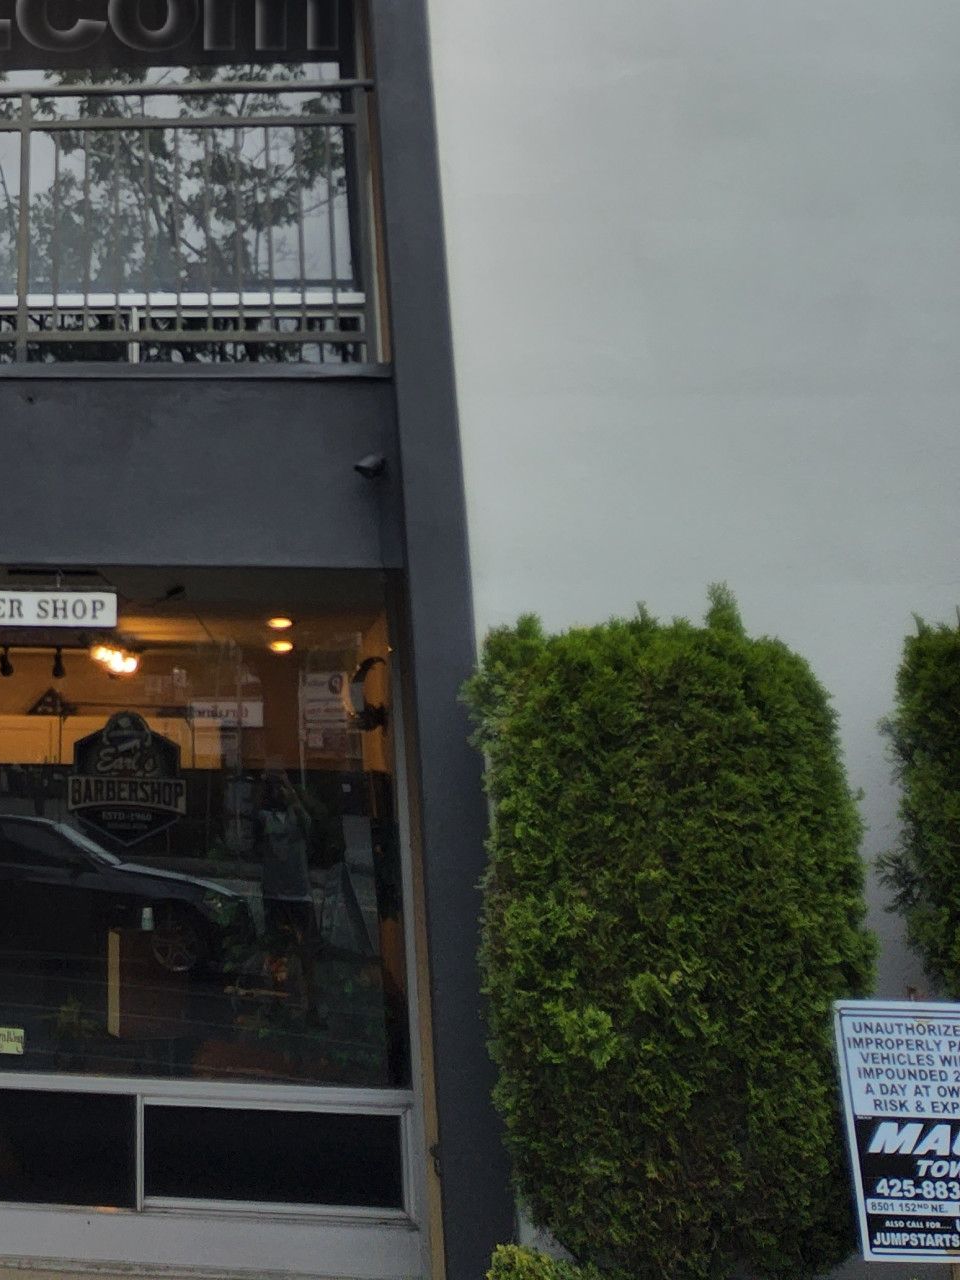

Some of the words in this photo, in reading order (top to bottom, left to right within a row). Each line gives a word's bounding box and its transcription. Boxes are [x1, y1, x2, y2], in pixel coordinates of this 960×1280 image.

[36, 598, 106, 621] SHOP
[71, 778, 183, 809] BARBERSHOP
[847, 1037, 942, 1051] IMPROPERLY
[860, 1052, 935, 1066] VEHICLES
[857, 1067, 948, 1082] IMPOUNDED
[865, 1083, 875, 1095] A
[880, 1084, 907, 1097] DAY
[914, 1085, 931, 1097] AT
[873, 1099, 910, 1112] RISK
[915, 1100, 925, 1113] &
[869, 1121, 960, 1156] MA
[871, 1202, 894, 1211] 8501
[885, 1220, 904, 1228] ALSO
